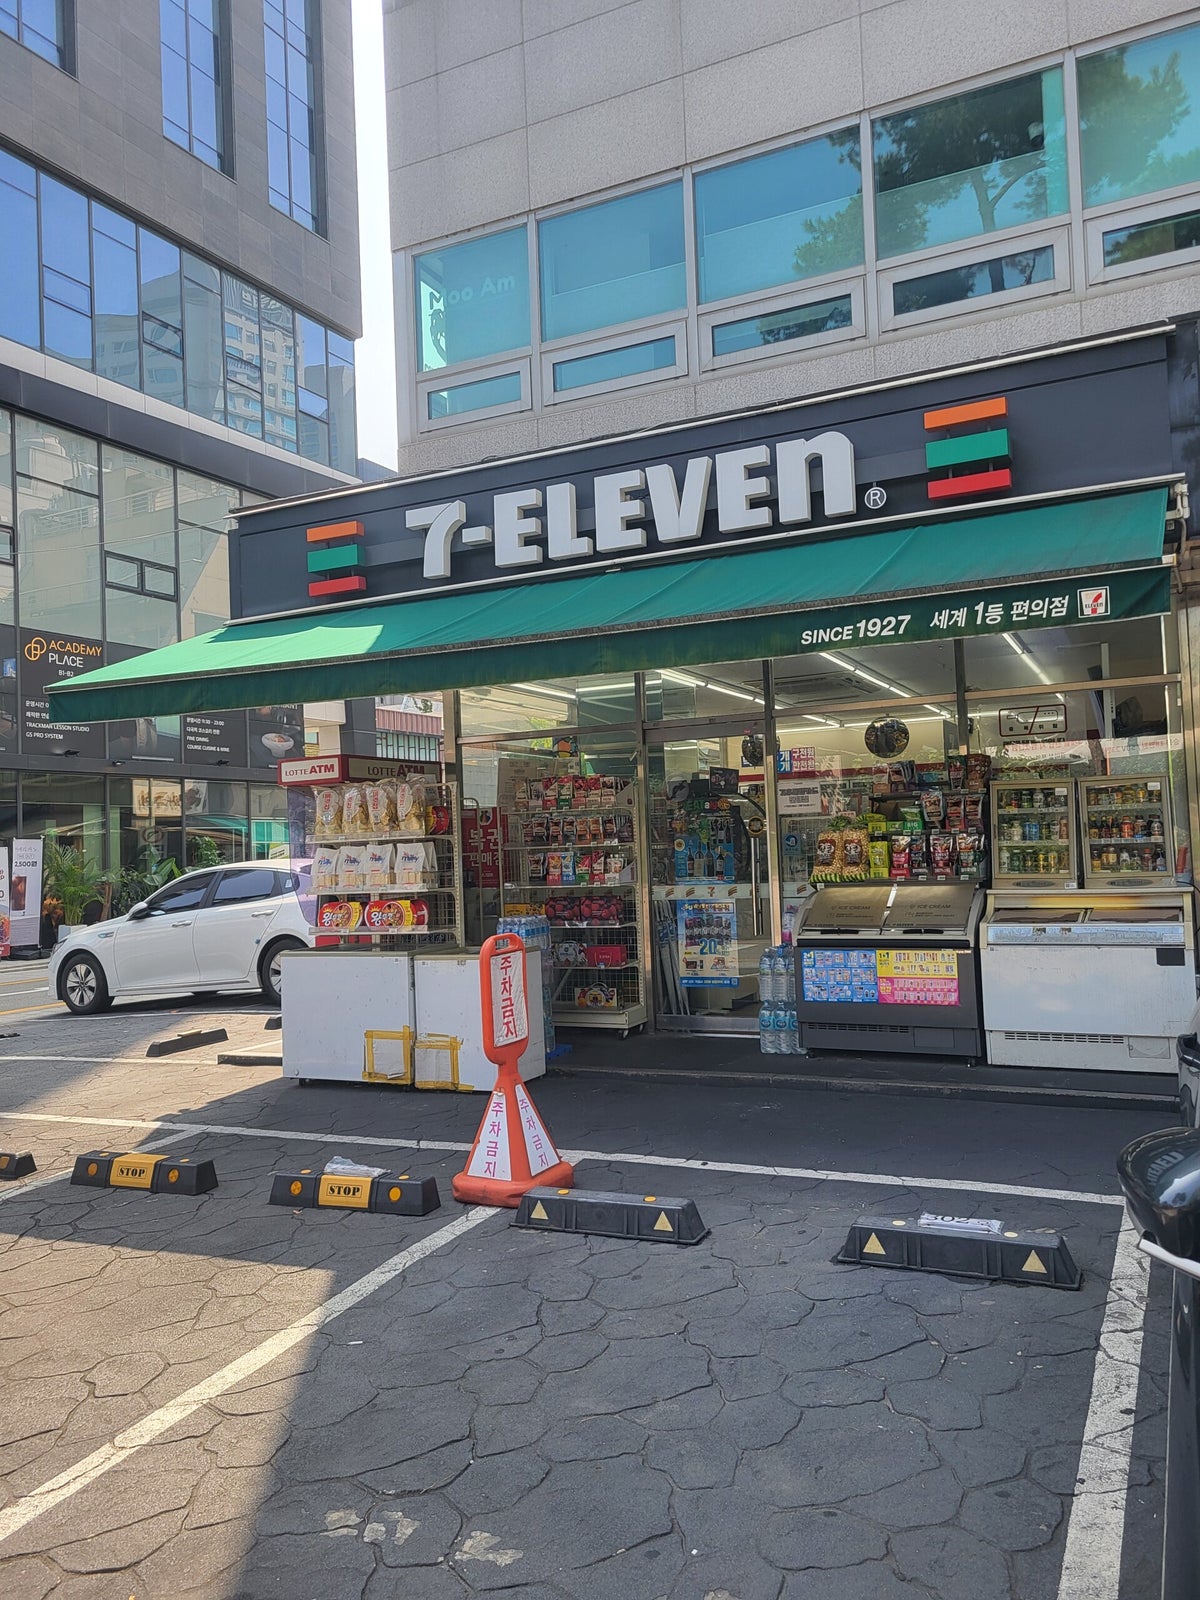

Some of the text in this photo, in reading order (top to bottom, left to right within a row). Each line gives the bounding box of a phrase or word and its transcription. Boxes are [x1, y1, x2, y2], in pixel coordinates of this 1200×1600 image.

[801, 595, 1069, 645] SINCE 1927 세계 1등 편의점
[49, 640, 102, 656] ACADEMY
[49, 653, 84, 667] PLACE
[26, 722, 54, 730] TRACKMAN
[54, 723, 72, 731] LESSON
[285, 764, 335, 777] LOTTE ATM
[368, 764, 425, 777] LOTTE ATM
[468, 828, 503, 850] 복권
[500, 955, 518, 1039] 주차금지
[484, 1101, 504, 1178] 주차금지
[519, 1097, 550, 1168] 주차금지
[118, 1166, 146, 1178] STOP
[328, 1184, 361, 1197] STOP
